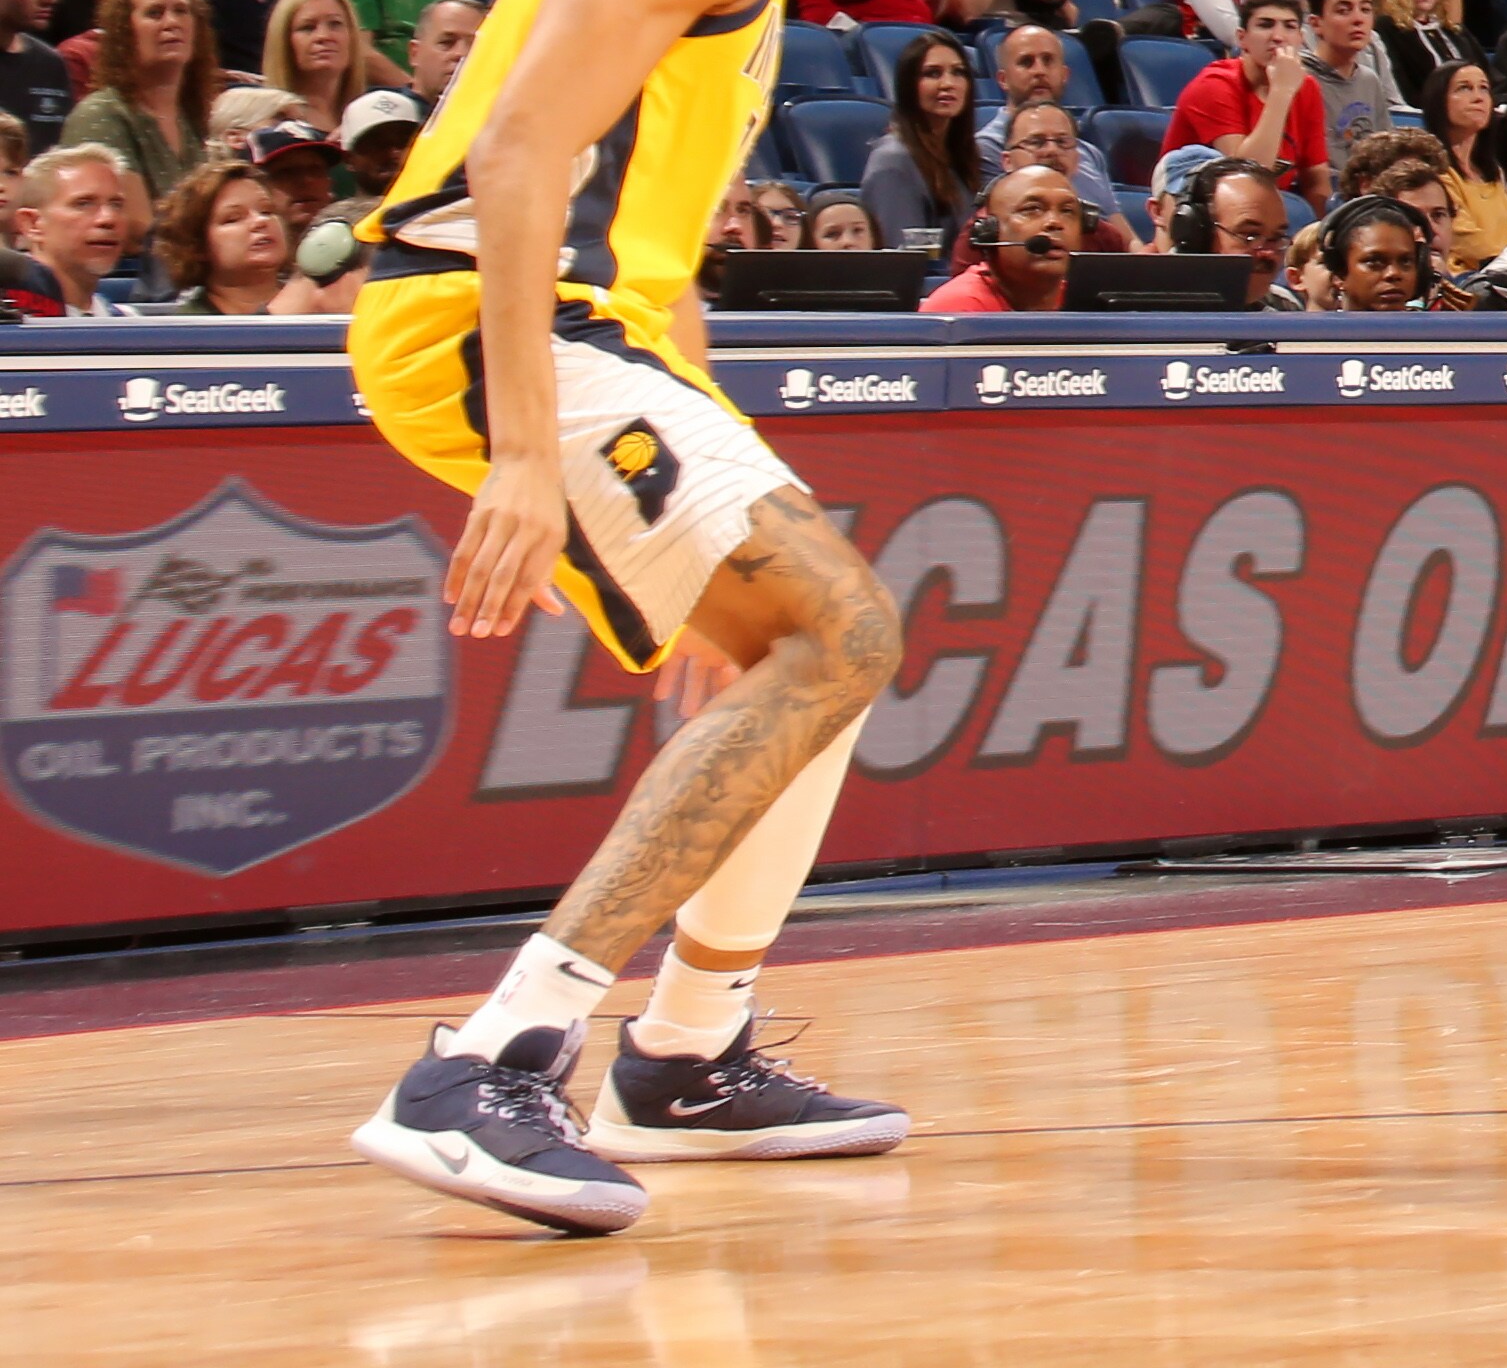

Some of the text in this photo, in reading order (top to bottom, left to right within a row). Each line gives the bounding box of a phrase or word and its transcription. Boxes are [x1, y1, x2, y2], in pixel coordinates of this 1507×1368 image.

[818, 374, 918, 404] SeatGeek
[1012, 368, 1107, 398] SeatGeek
[1196, 365, 1286, 395] SeatGeek
[1370, 364, 1455, 393] SeatGeek
[165, 382, 286, 415] SeatGeek
[49, 606, 426, 711] LUCAS
[472, 487, 1308, 810] LCAS
[18, 720, 425, 781] OIL PRODUCTS
[171, 790, 289, 833] INC.
